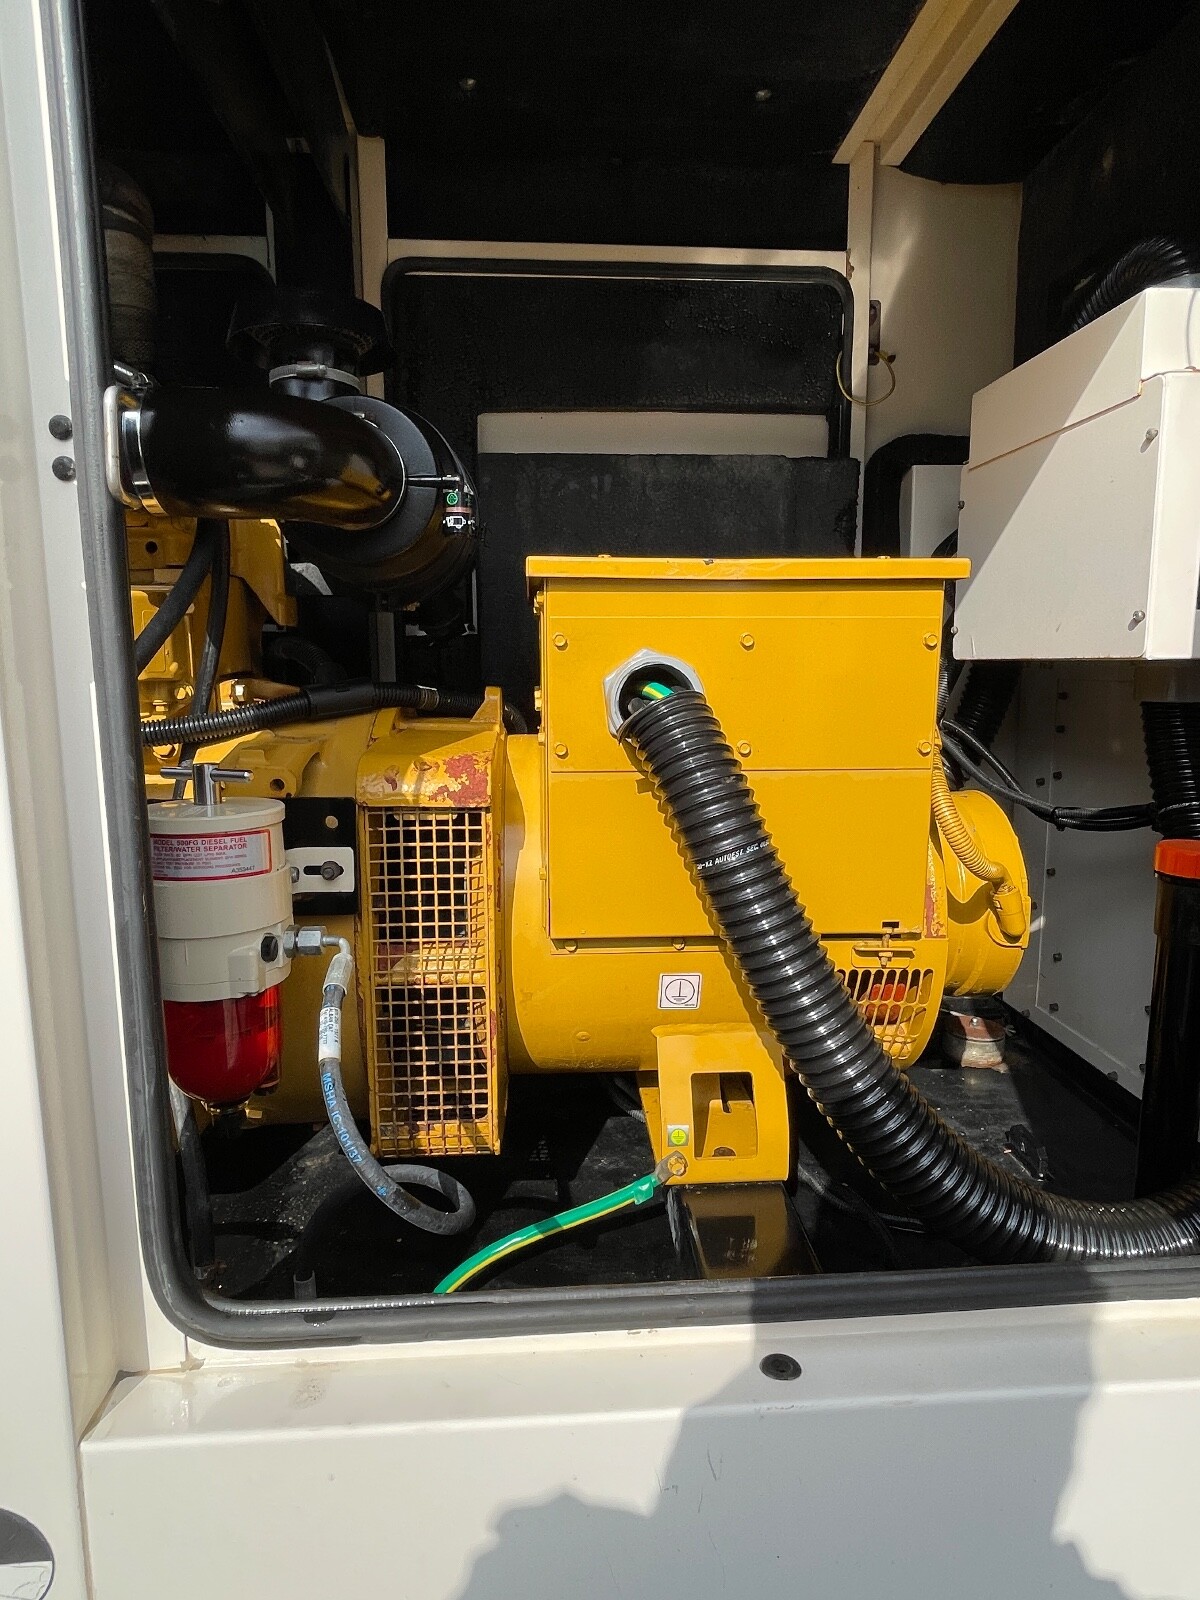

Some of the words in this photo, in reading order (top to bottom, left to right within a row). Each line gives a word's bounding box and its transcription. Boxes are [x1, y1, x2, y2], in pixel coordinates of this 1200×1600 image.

[201, 838, 228, 846] DIESEL
[203, 843, 247, 852] SEPARATOR
[322, 1072, 337, 1109] MSHA
[330, 1110, 362, 1163] IC-101/37
